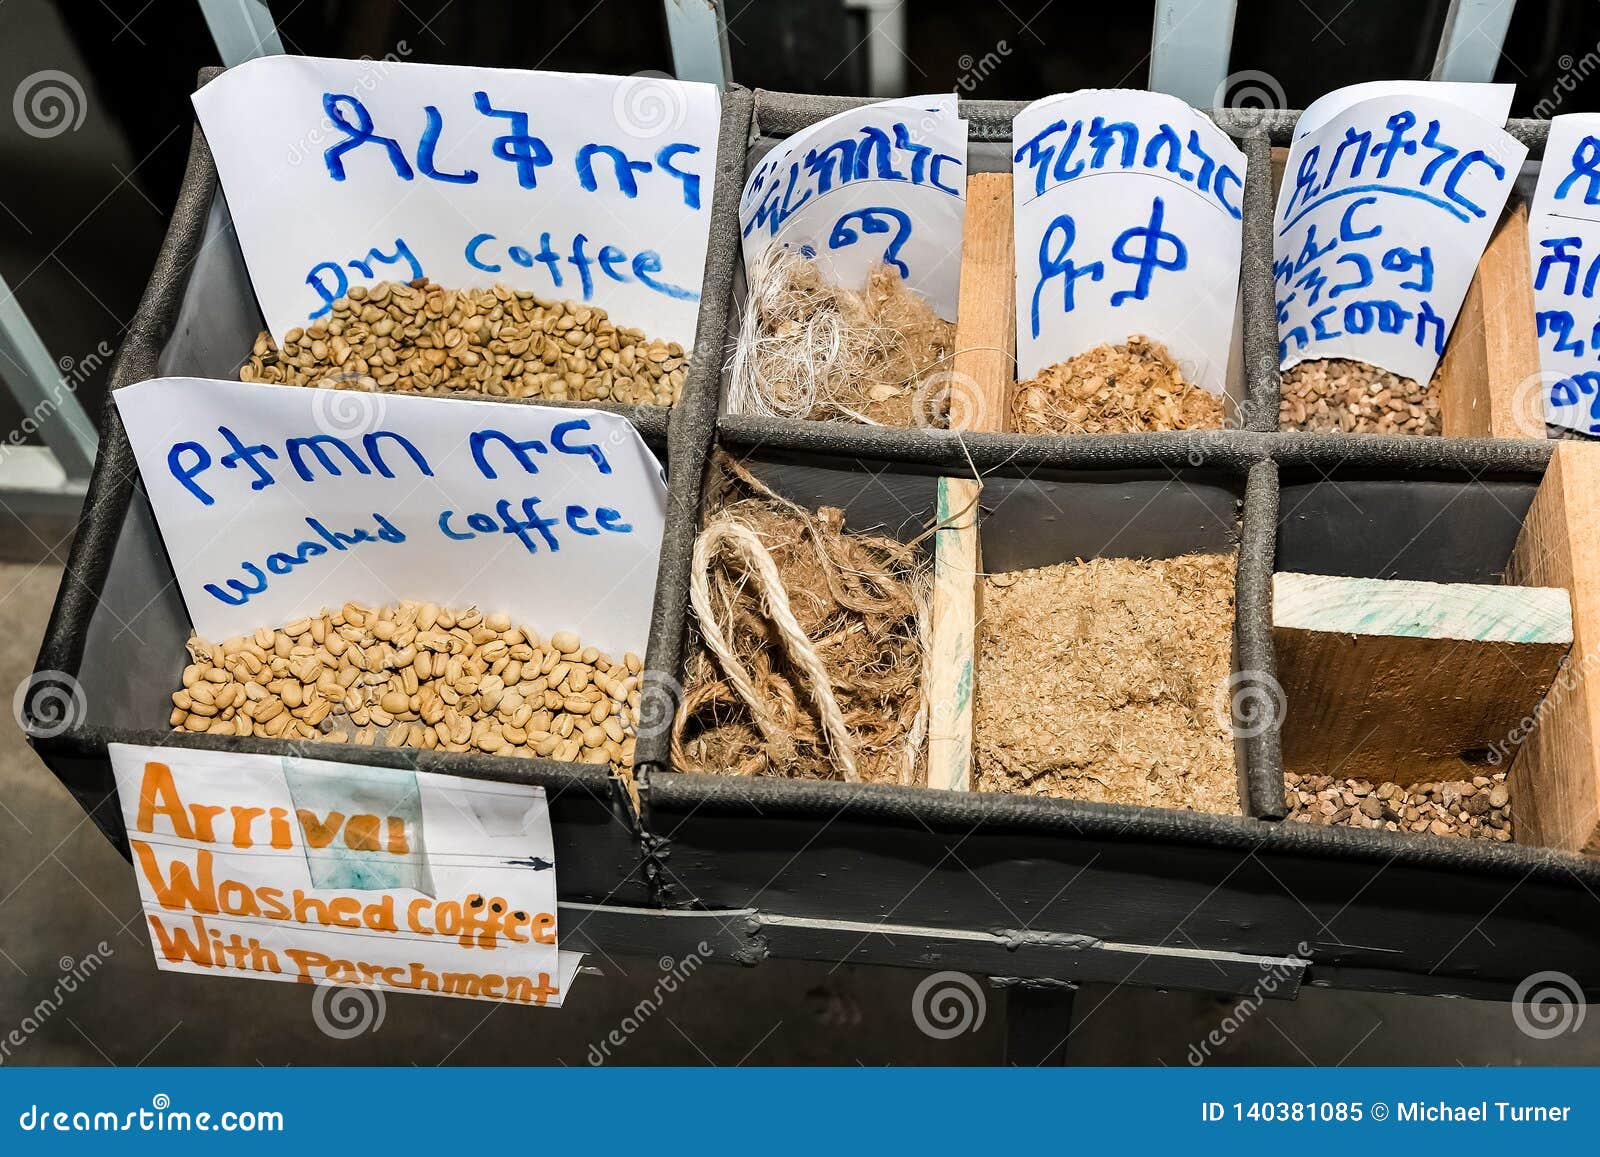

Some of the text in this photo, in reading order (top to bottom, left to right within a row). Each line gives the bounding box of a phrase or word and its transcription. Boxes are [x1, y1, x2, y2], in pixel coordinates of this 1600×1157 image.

[576, 143, 701, 210] ቡና
[305, 238, 424, 320] Dry
[469, 419, 612, 480] ቡና
[131, 839, 400, 934] Washed
[148, 915, 281, 973] With
